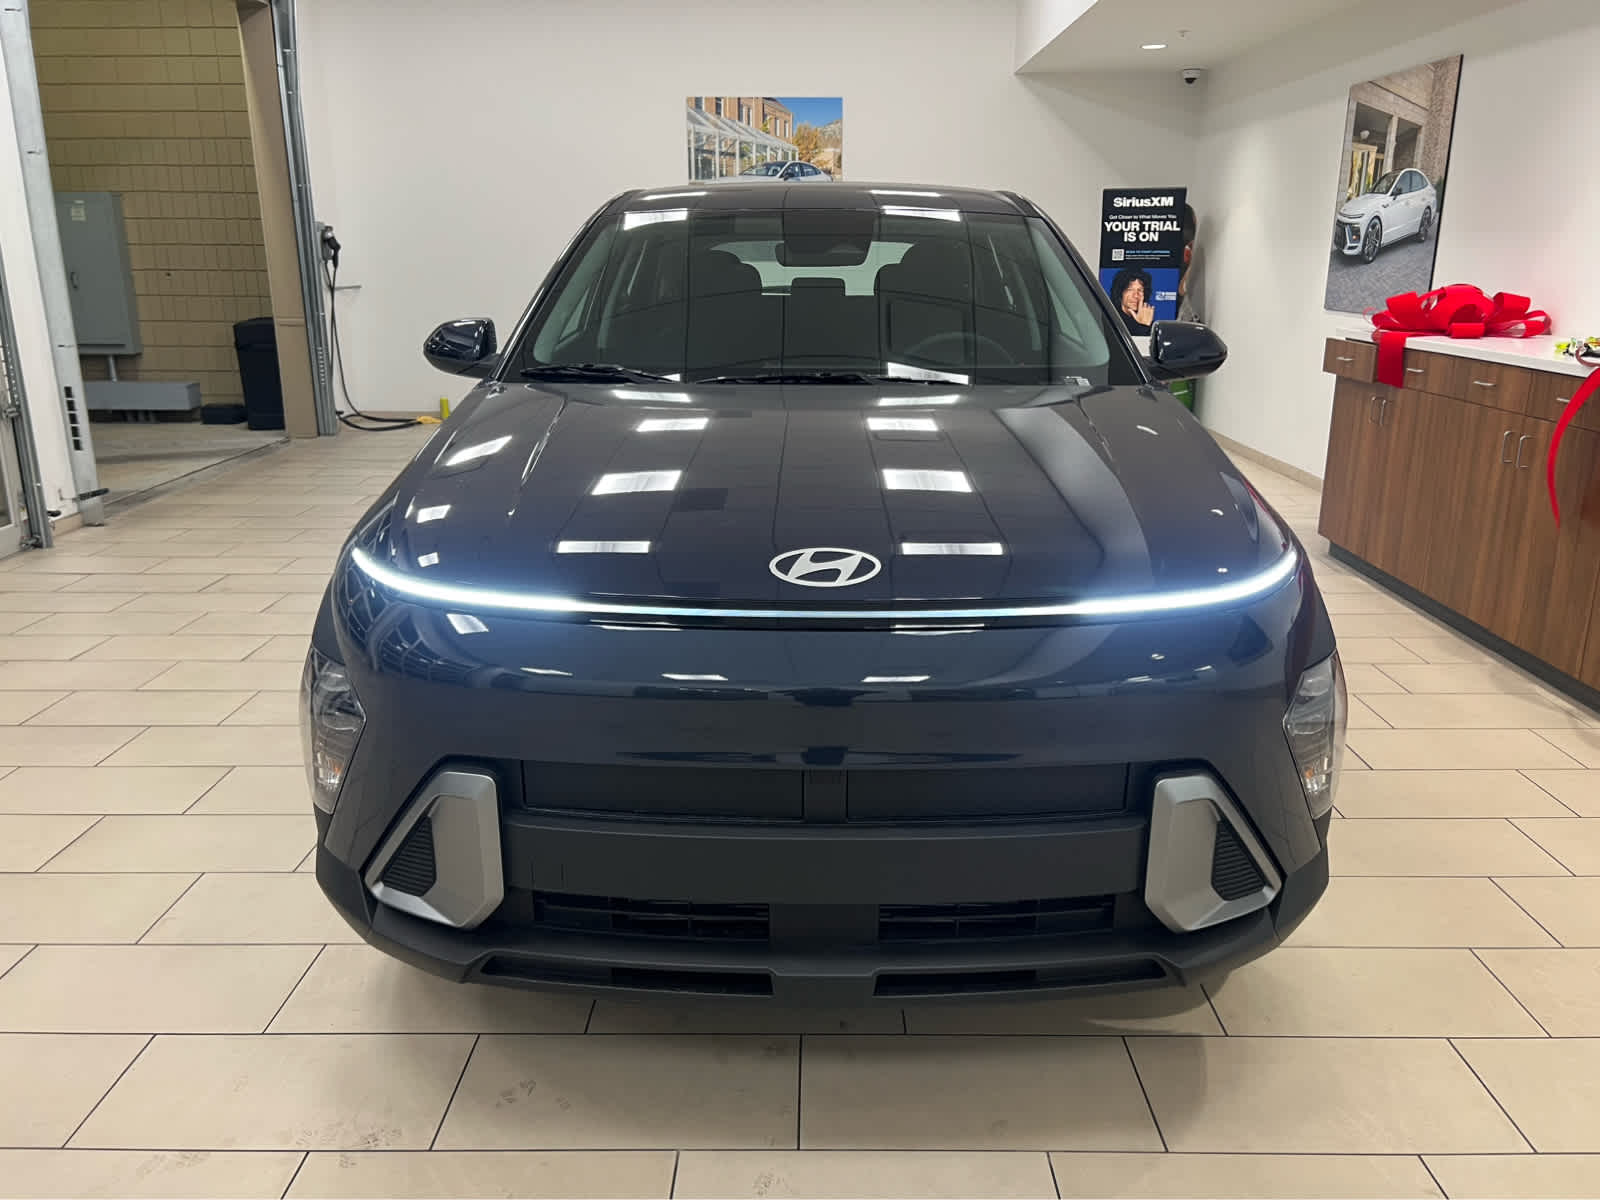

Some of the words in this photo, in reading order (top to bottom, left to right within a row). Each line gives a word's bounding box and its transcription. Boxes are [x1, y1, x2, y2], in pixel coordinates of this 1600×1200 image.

[1113, 196, 1174, 208] SiriusXM
[1104, 221, 1140, 232] YOUR
[1142, 221, 1181, 232] TRIAL
[1124, 231, 1137, 242] IS
[1139, 231, 1159, 242] ON
